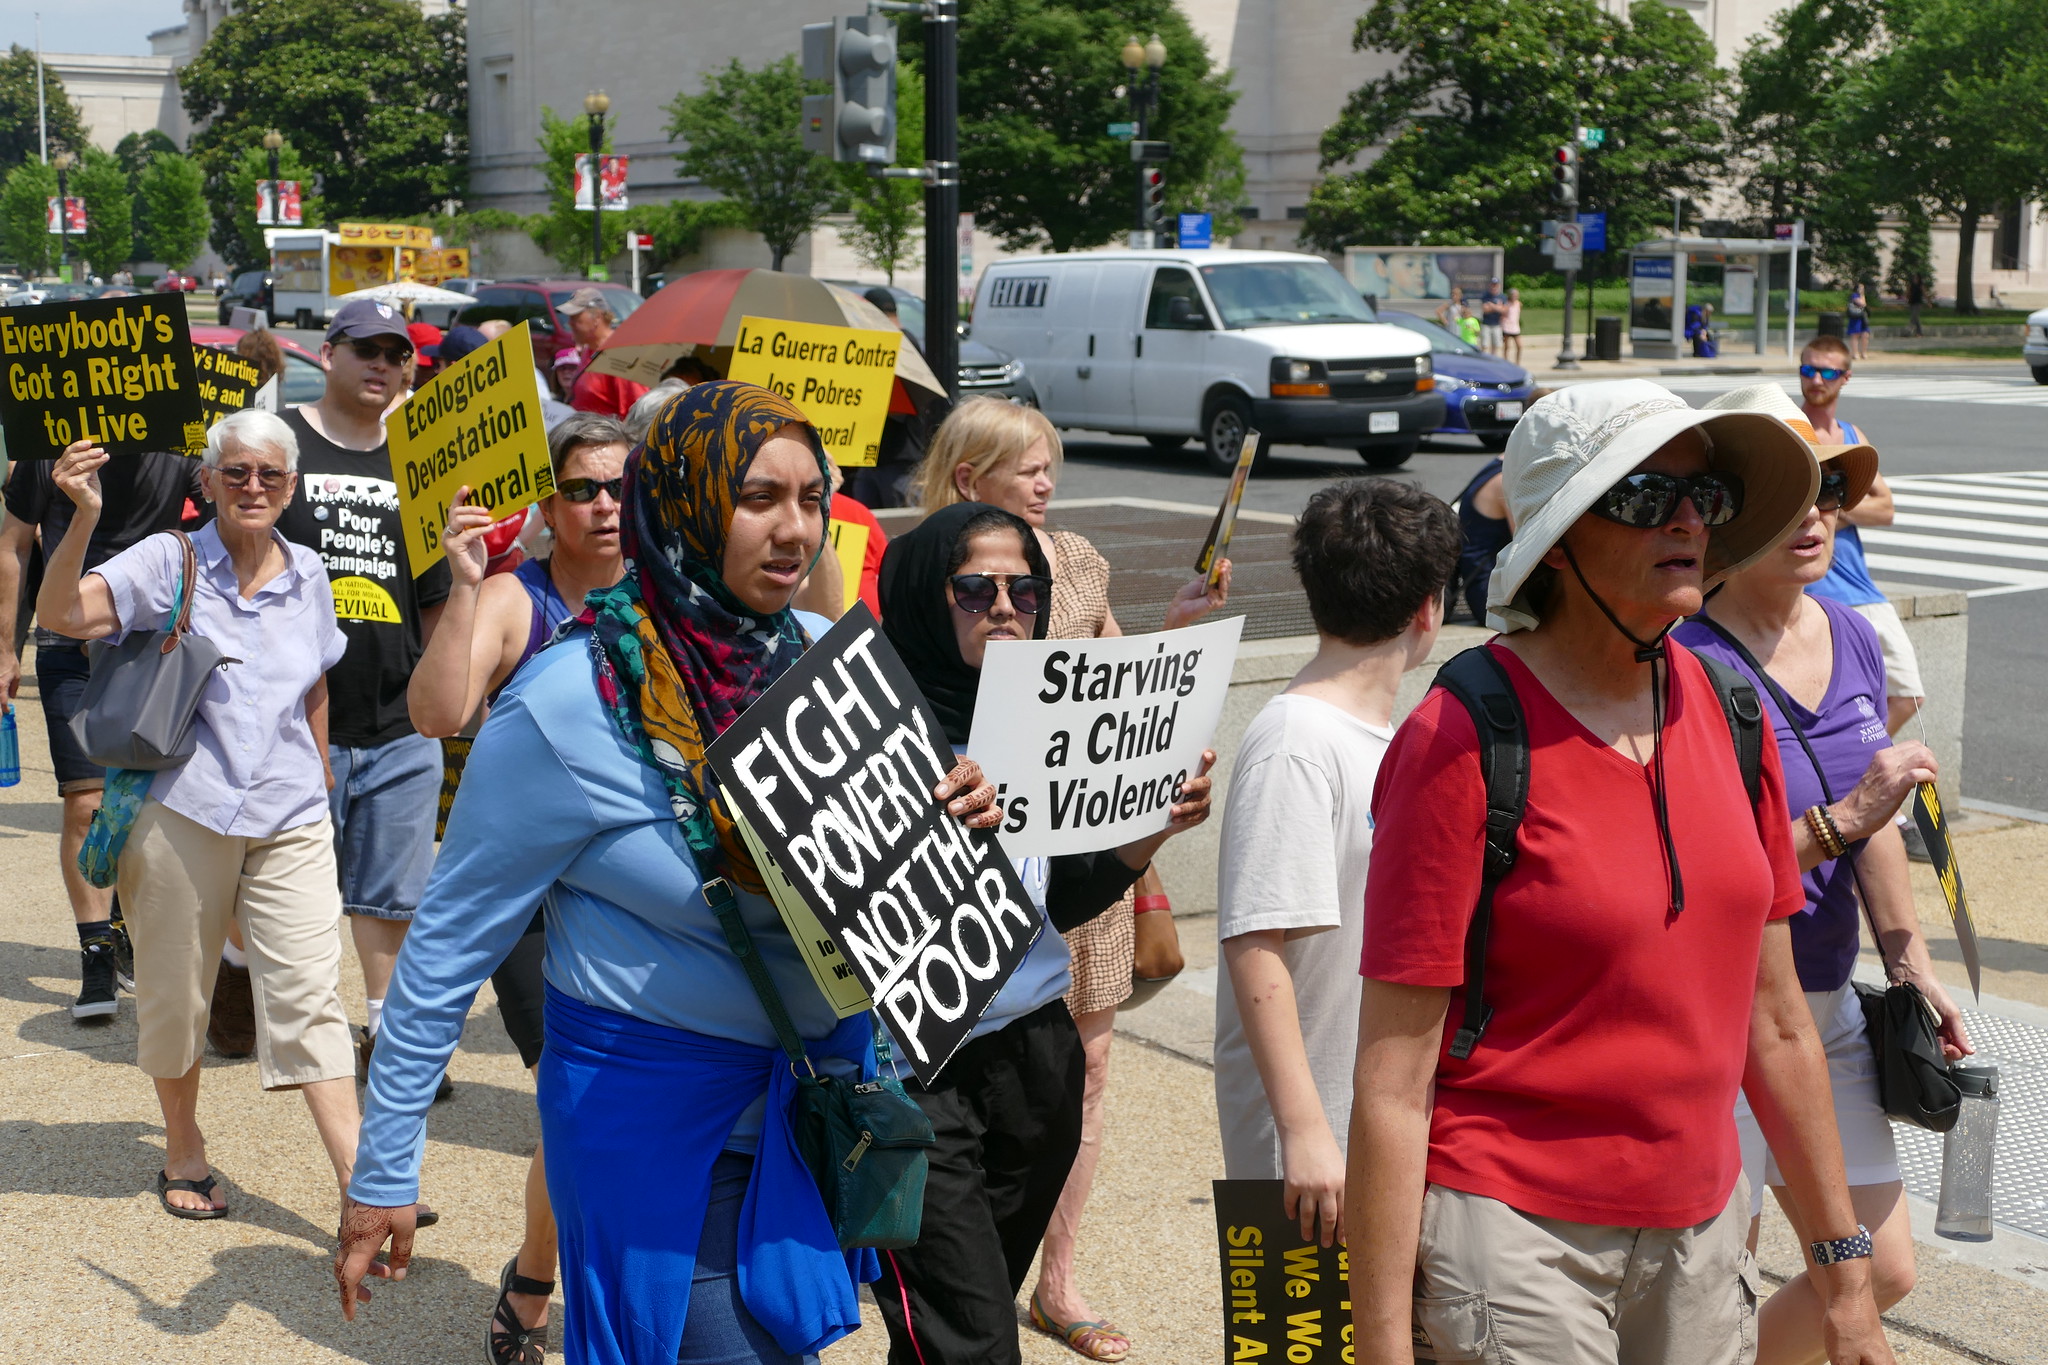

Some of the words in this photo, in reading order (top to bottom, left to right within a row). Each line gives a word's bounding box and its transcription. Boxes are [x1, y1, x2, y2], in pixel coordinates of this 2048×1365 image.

[991, 278, 1048, 306] HITT
[0, 304, 174, 358] Everybody's
[738, 327, 764, 354] La
[772, 331, 838, 364] Guerra
[844, 339, 896, 368] Contra
[9, 362, 55, 401] Got
[62, 369, 79, 398] a
[87, 354, 179, 401] Right
[215, 353, 259, 388] Hurting
[404, 339, 508, 441] Ecological
[767, 373, 796, 400] los
[802, 376, 863, 407] Pobres
[220, 388, 245, 408] and
[44, 410, 72, 446] to
[79, 405, 148, 444] Live
[405, 400, 527, 500] Devastation
[320, 528, 396, 556] People's
[338, 507, 381, 533] Poor
[420, 515, 438, 553] is
[318, 552, 397, 579] Campaign
[332, 588, 345, 596] ALL
[346, 589, 360, 597] FOR
[334, 598, 388, 618] EVIVAL
[1038, 642, 1203, 703] Starving
[731, 627, 902, 838] FIGHT
[1045, 730, 1070, 768] a
[1087, 700, 1179, 764] Child
[787, 705, 945, 916] POVERTY
[995, 783, 1029, 834] is
[1049, 768, 1187, 831] Violence
[840, 862, 940, 988] NOT
[911, 809, 989, 906] THE
[884, 867, 1031, 1064] POOR
[1226, 1225, 1266, 1324] Silent
[1283, 1245, 1320, 1298] We
[1287, 1309, 1322, 1364] Wo
